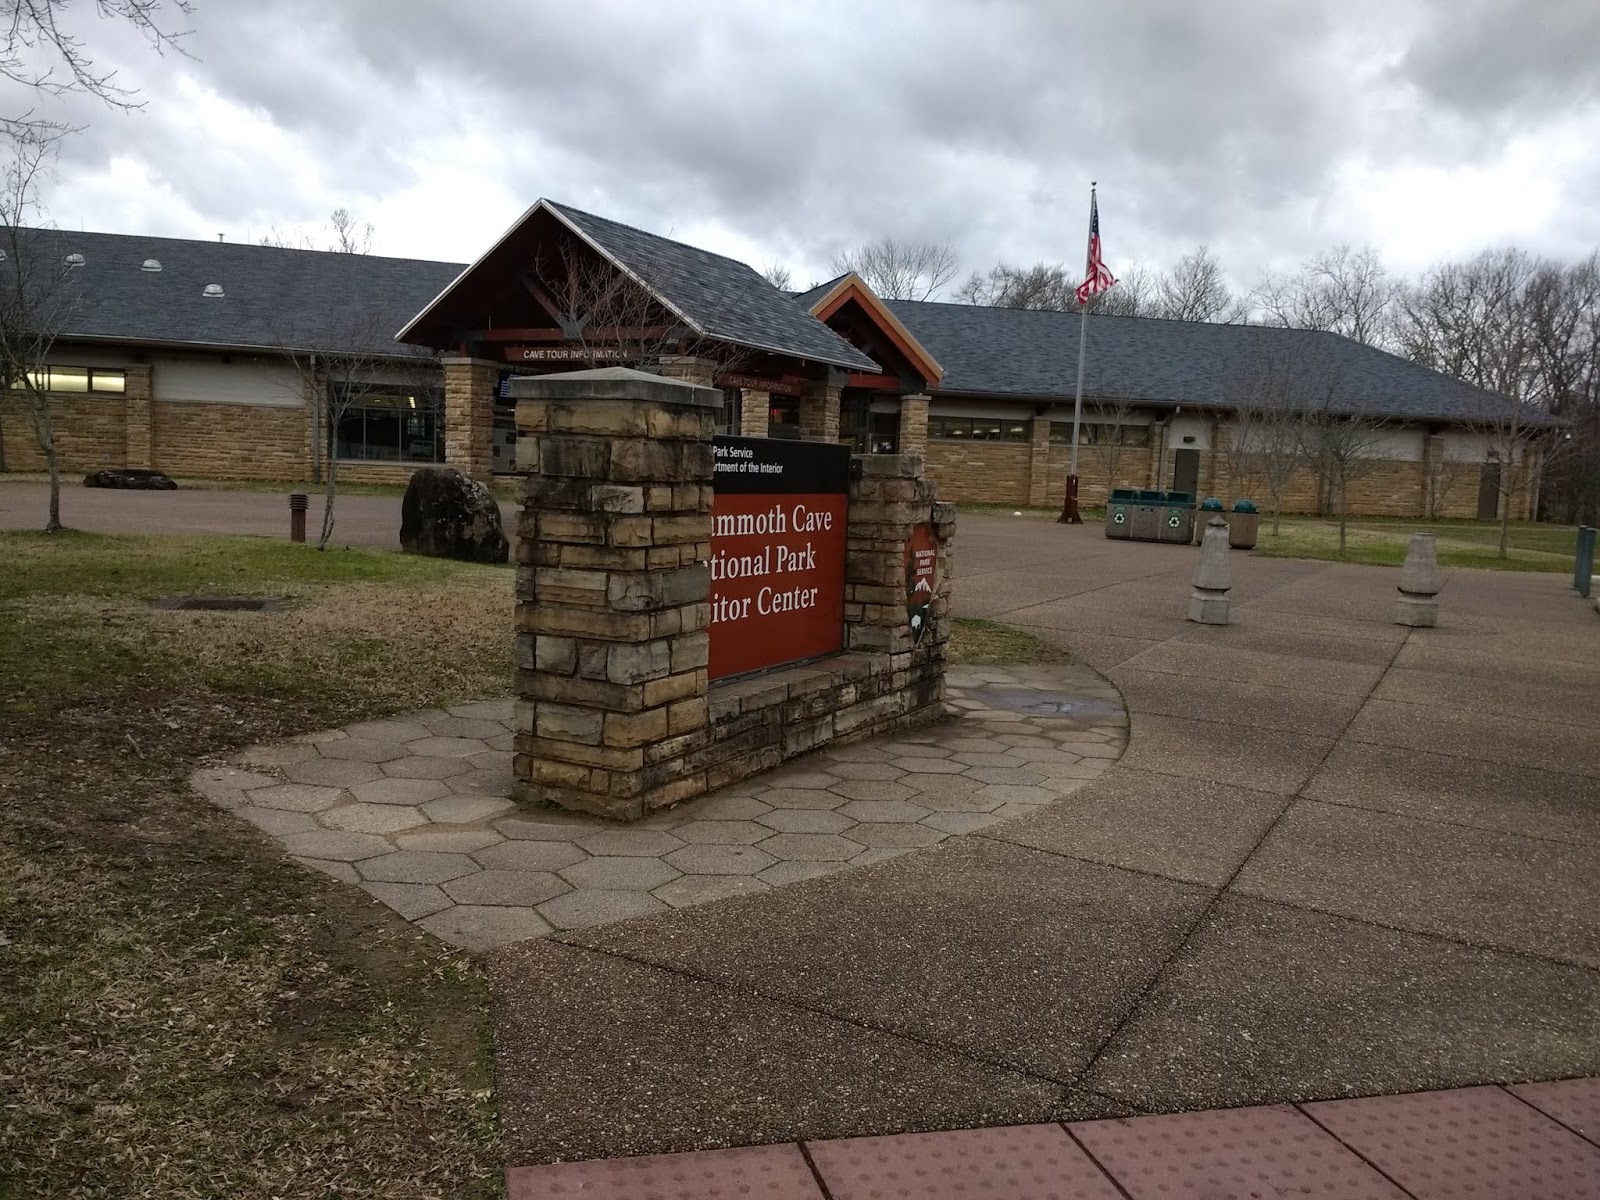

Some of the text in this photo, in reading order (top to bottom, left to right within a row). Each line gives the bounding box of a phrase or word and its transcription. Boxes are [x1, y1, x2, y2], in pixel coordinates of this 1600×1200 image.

[523, 349, 545, 359] CAVE
[546, 349, 569, 359] TOUR
[744, 377, 757, 388] TOUR
[759, 380, 792, 393] INFORMATION
[713, 445, 753, 458] Park Service
[740, 461, 747, 473] of
[748, 462, 759, 473] the
[760, 462, 783, 474] Interior
[711, 504, 832, 537] mmoth Cave
[915, 549, 935, 558] NATIONAL
[710, 542, 816, 581] tional Park
[920, 558, 931, 567] PARK
[916, 566, 933, 576] SERVICE
[712, 585, 818, 623] itor Center
